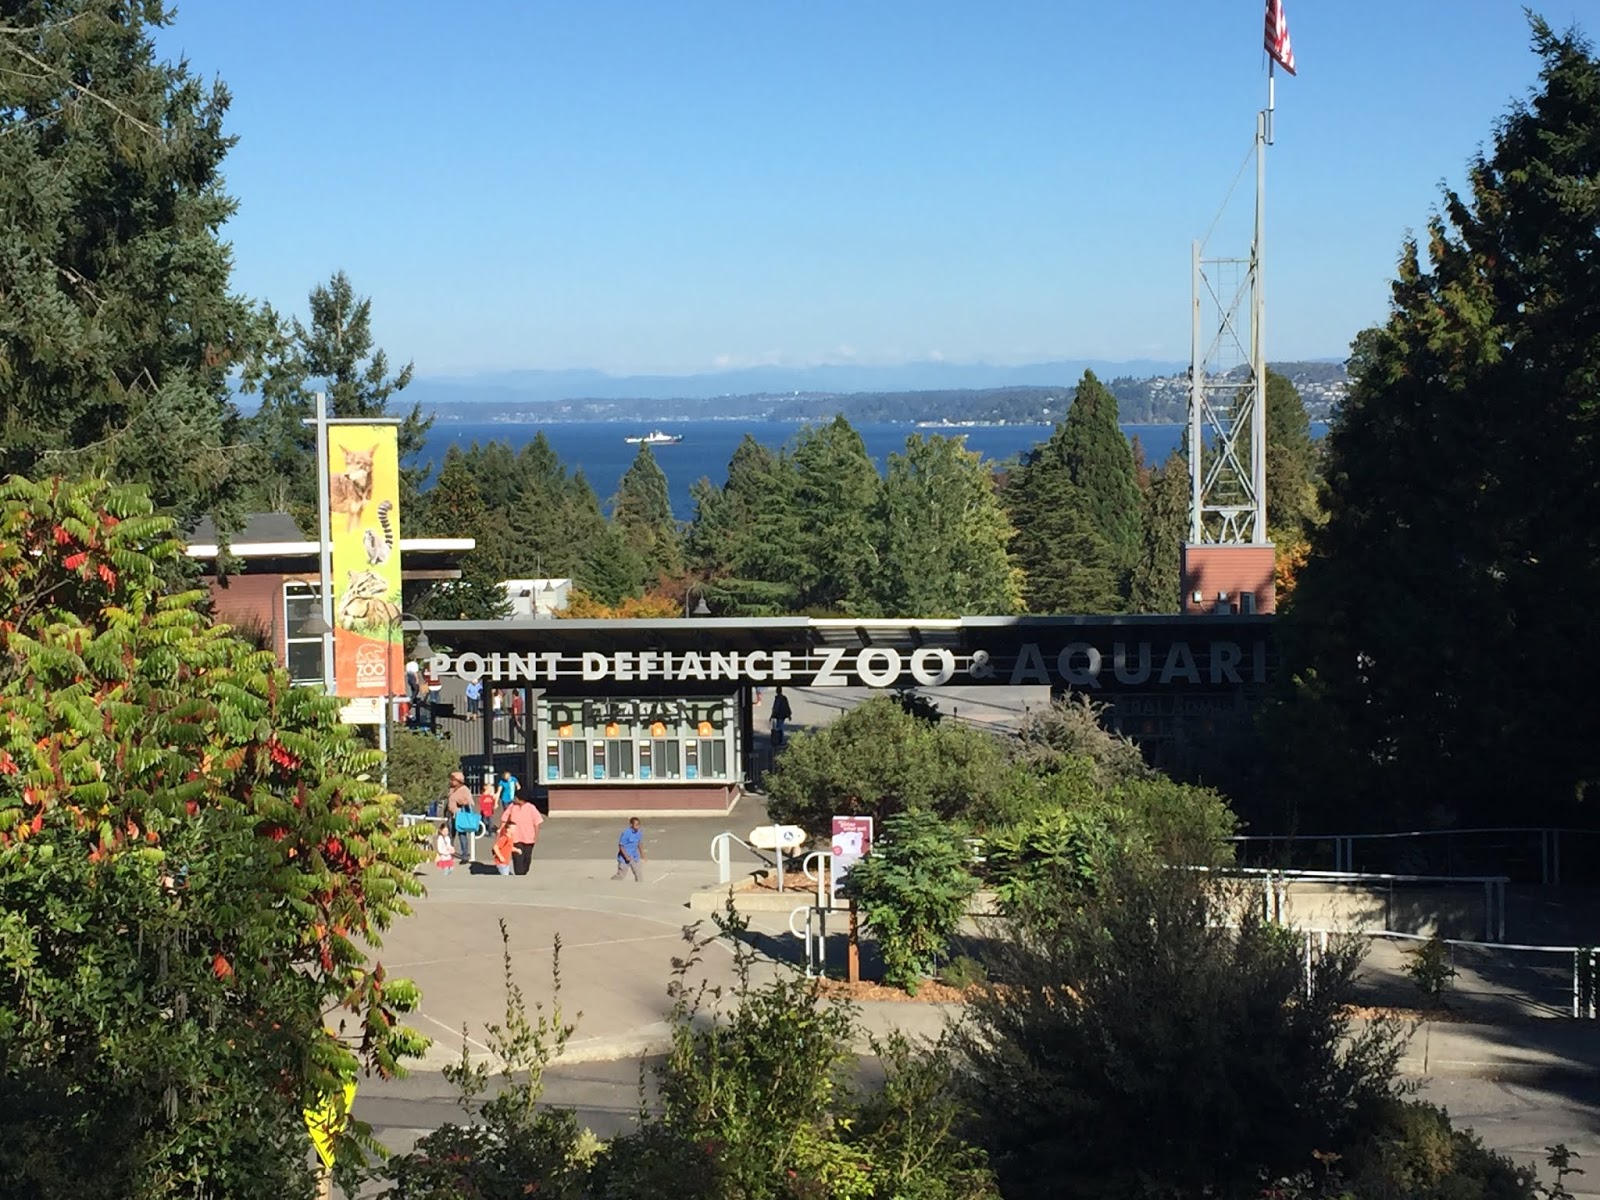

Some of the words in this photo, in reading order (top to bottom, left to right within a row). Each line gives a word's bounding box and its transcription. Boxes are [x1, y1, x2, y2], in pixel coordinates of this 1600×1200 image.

[356, 663, 386, 677] ZOO
[430, 652, 562, 681] POINT
[582, 651, 791, 680] DEFIANCE
[811, 647, 955, 687] ZOO
[969, 650, 997, 679] &
[1010, 642, 1267, 689] AQUARI
